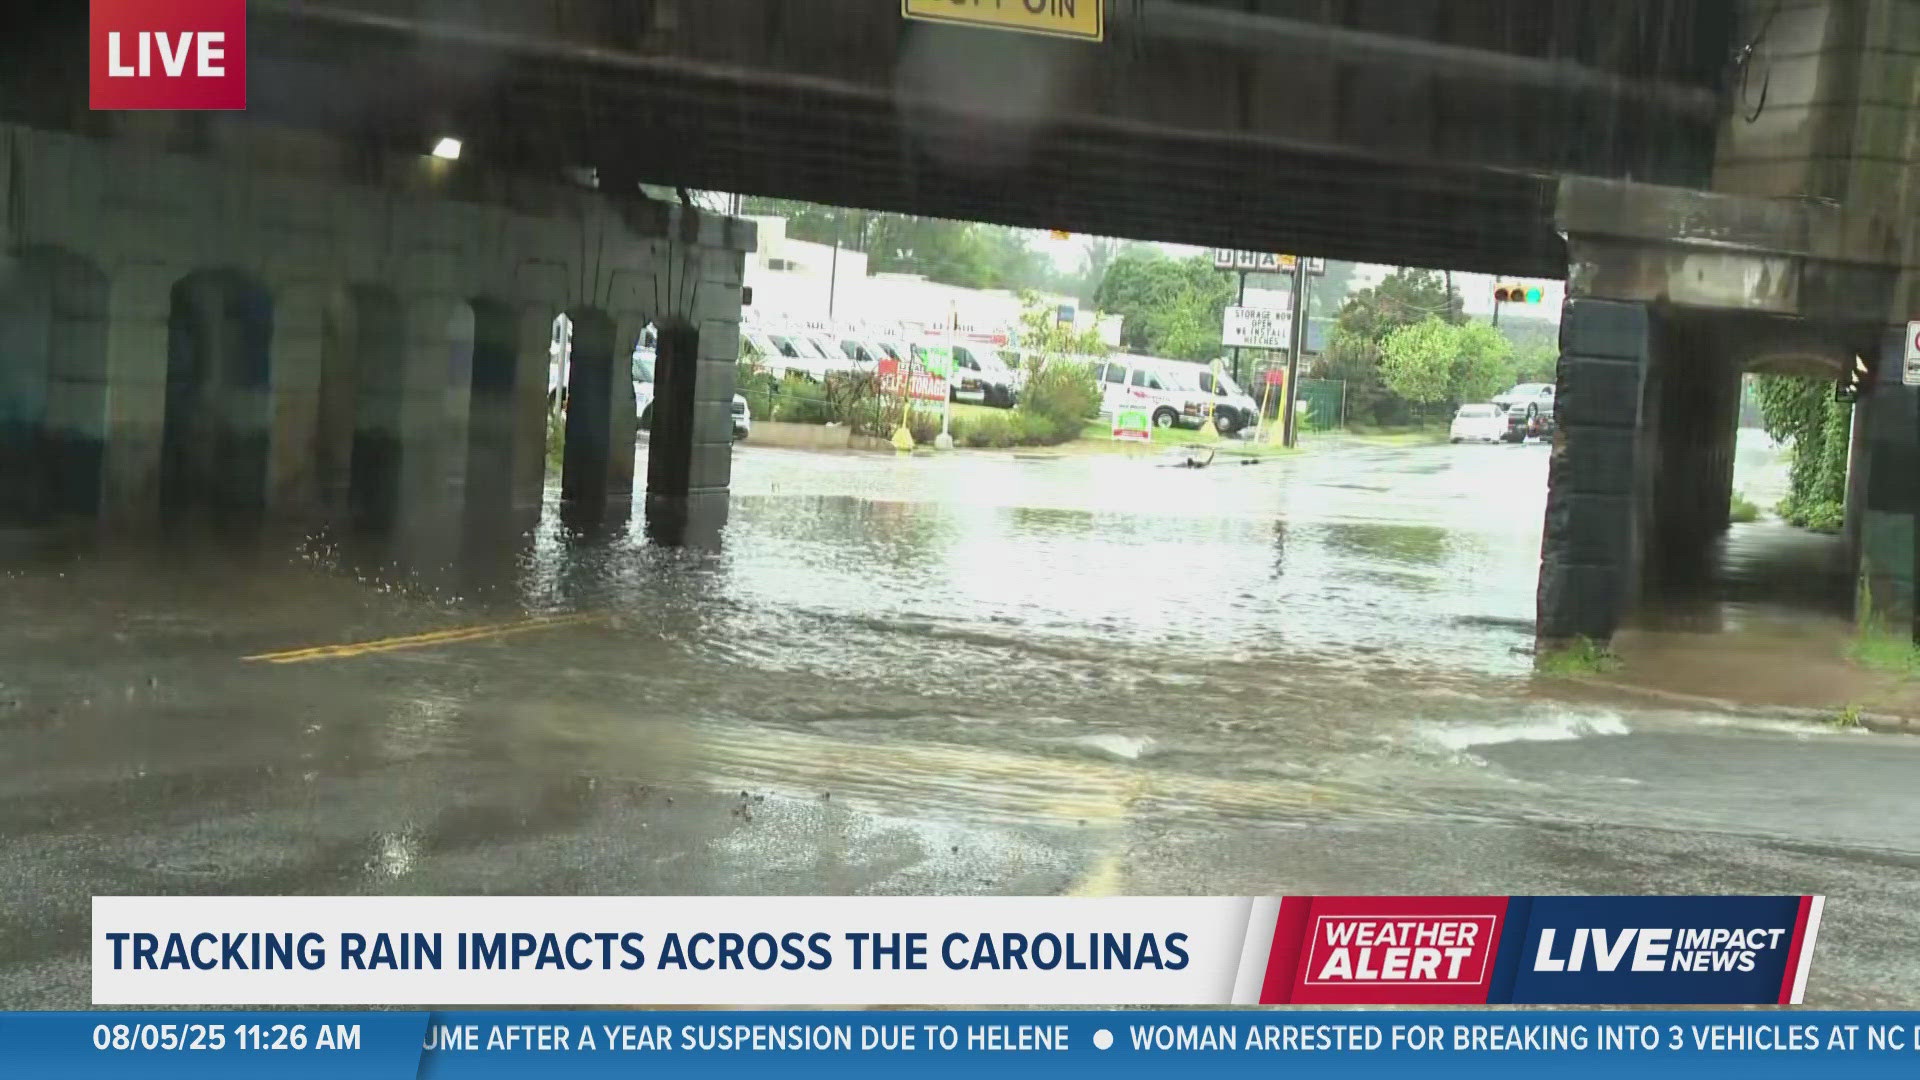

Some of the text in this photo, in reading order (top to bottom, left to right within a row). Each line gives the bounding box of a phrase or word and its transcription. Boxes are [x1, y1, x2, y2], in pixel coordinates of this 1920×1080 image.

[1235, 309, 1292, 320] STORAGE NOW
[1251, 319, 1272, 328] OPEN
[1250, 328, 1286, 338] INSTALL
[1244, 336, 1279, 346] HITCHES
